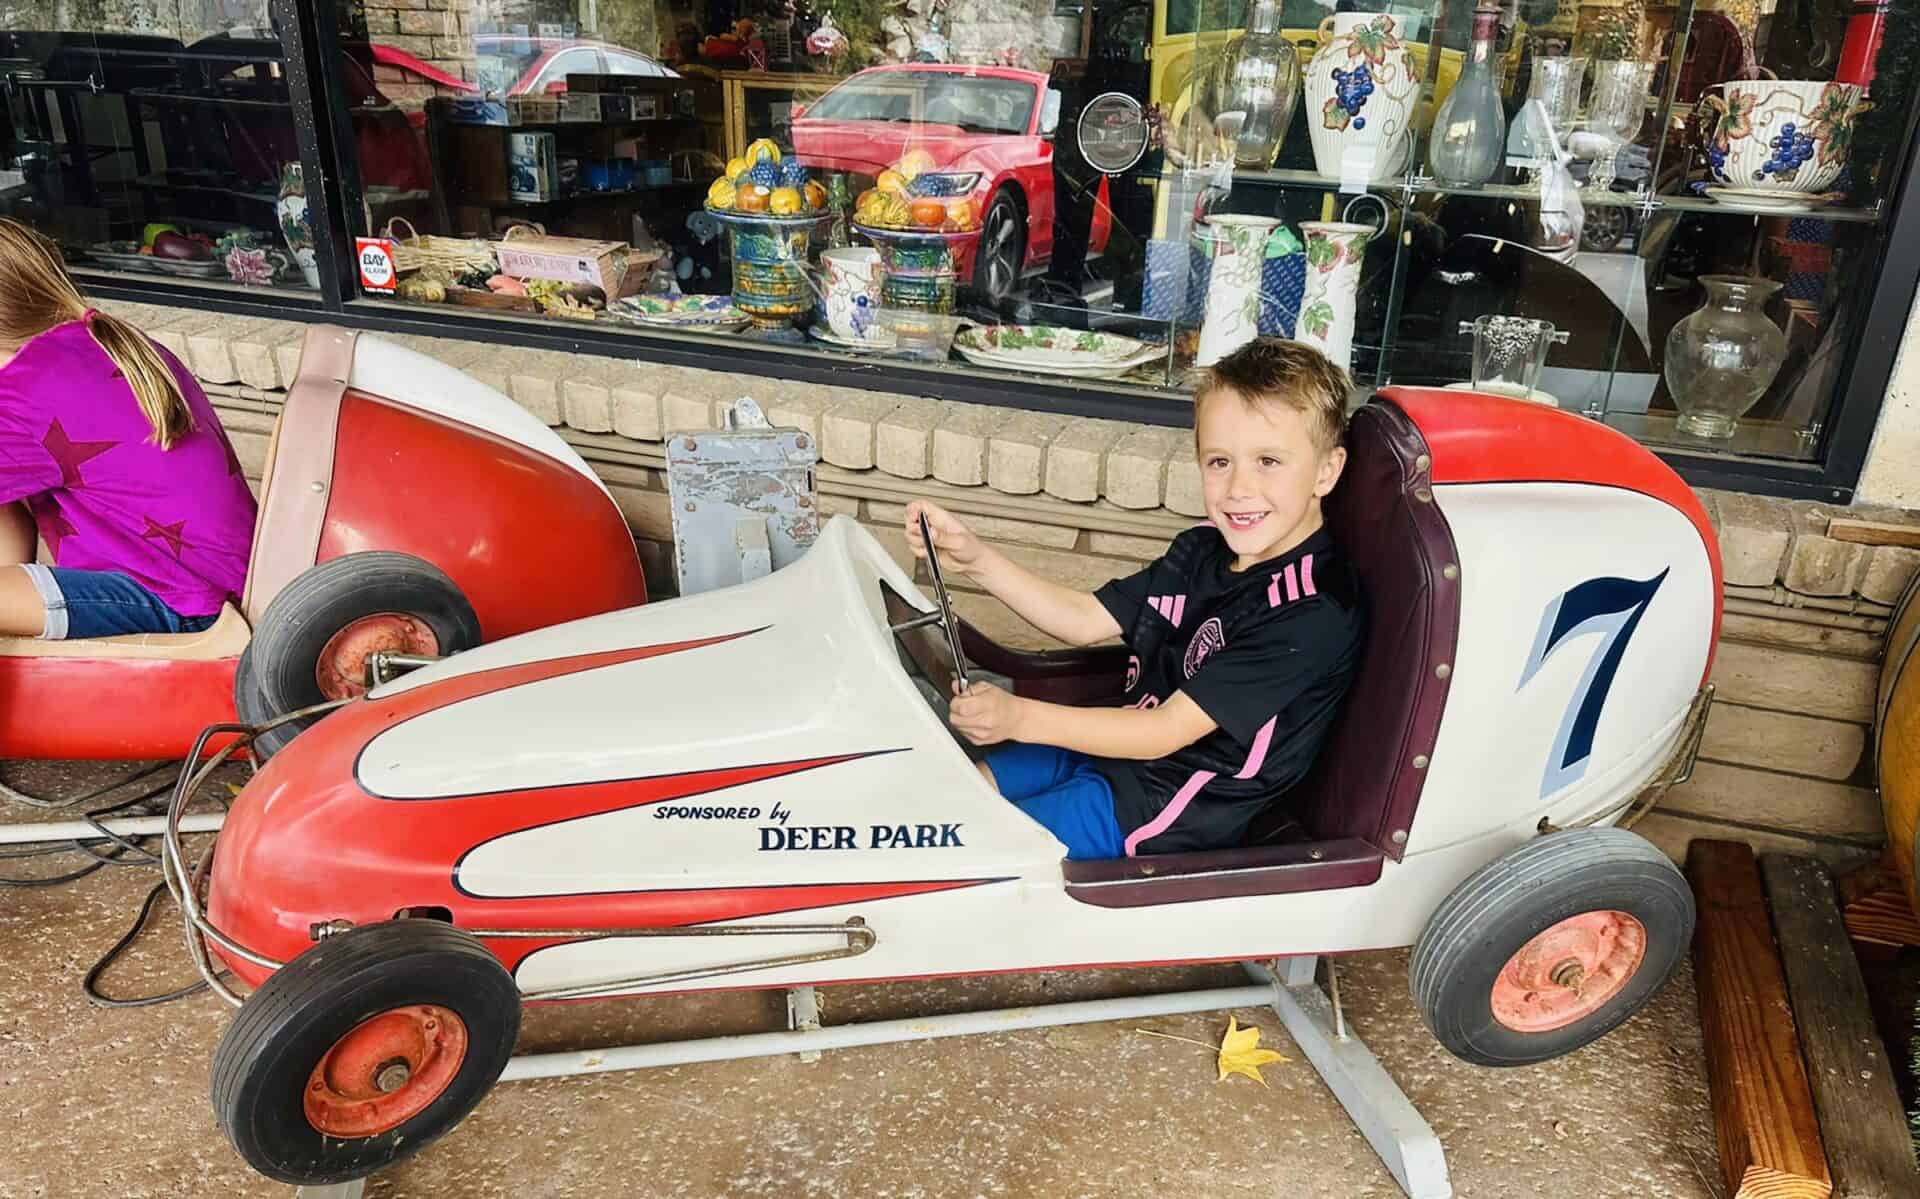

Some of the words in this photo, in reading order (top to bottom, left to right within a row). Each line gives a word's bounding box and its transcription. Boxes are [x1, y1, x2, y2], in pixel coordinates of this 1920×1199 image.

[363, 254, 385, 266] BAY
[1513, 564, 1670, 800] 7
[653, 805, 761, 820] SPONSORED
[769, 801, 791, 825] by
[757, 826, 859, 851] DEER
[868, 823, 965, 849] PARK
